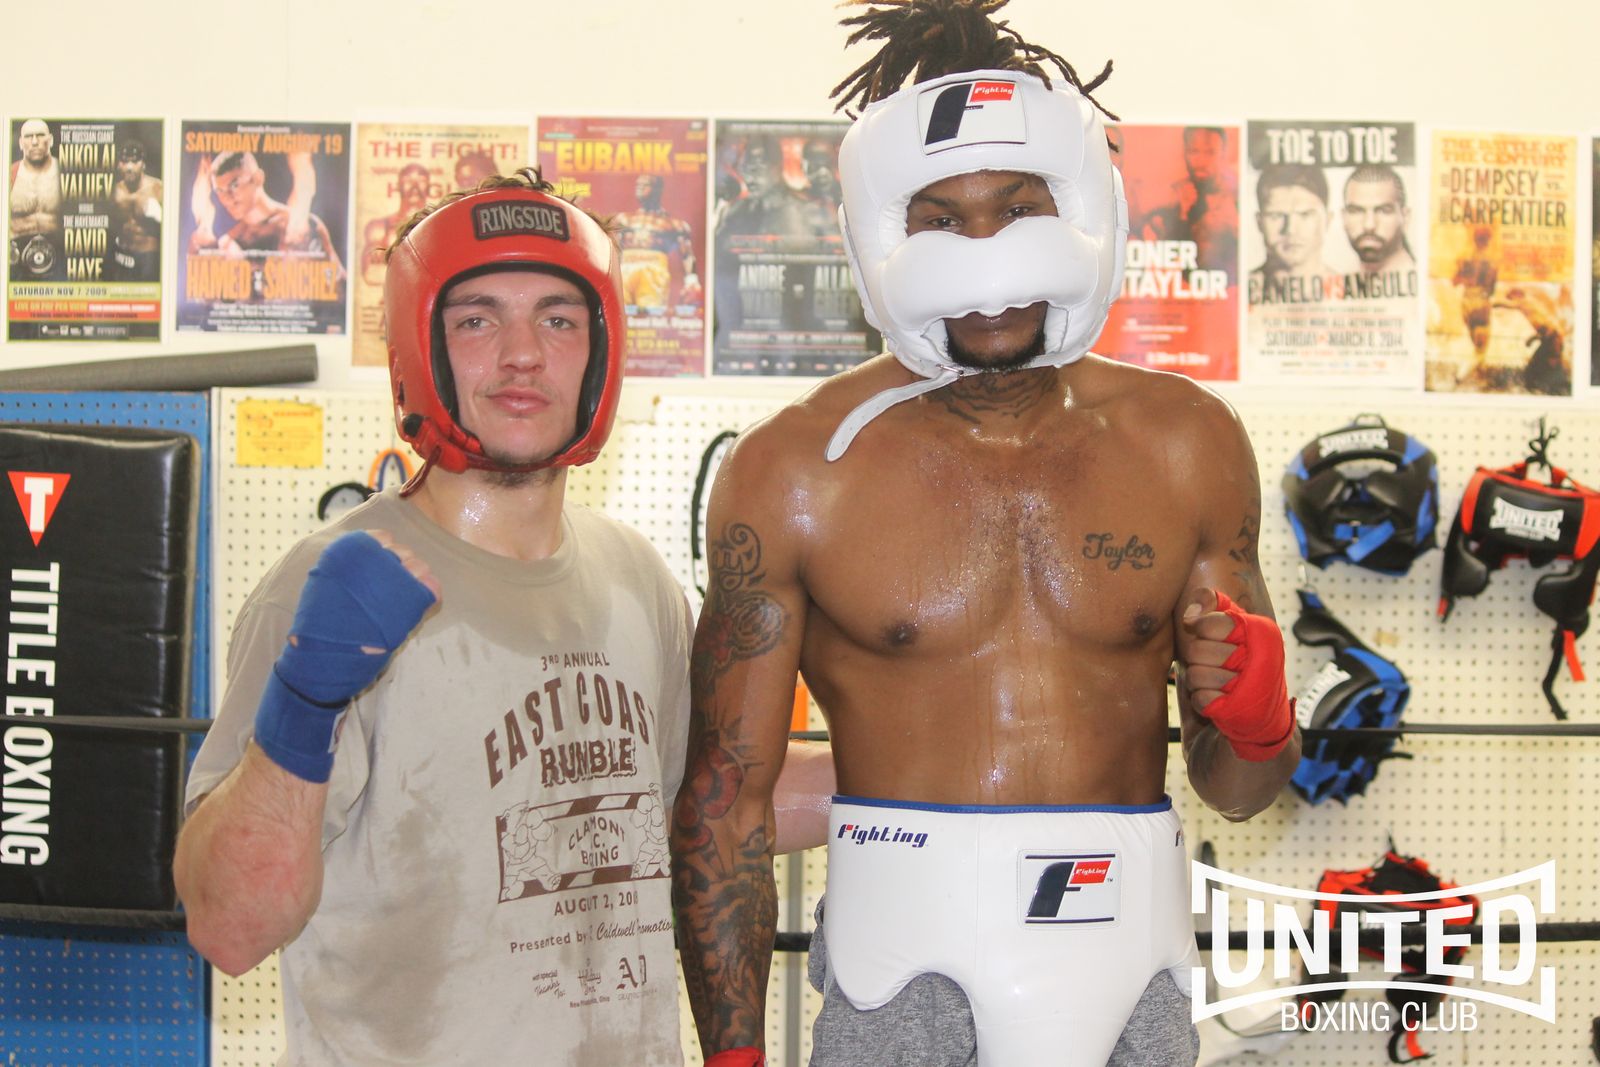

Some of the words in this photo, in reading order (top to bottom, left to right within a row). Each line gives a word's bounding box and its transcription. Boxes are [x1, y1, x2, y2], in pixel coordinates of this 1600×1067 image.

[185, 131, 261, 153] SATURDAY
[263, 132, 322, 154] AUGUST
[324, 134, 343, 155] 19
[368, 140, 421, 158] THE
[431, 141, 518, 160] FIGHT!
[556, 140, 674, 176] EUBANK
[1267, 128, 1316, 164] TOE
[1318, 130, 1350, 164] TO
[1349, 126, 1398, 164] TOE
[1450, 167, 1539, 197] DEMPSEY
[480, 205, 564, 235] RINGSIDE
[1450, 196, 1566, 227] CARPENTIER
[64, 228, 107, 255] DAVID
[1127, 240, 1198, 269] ONER
[13, 286, 55, 297] SATURDAY
[57, 286, 75, 297] NOV
[186, 256, 252, 300] HAMED
[263, 256, 338, 301] SANCHEZ
[738, 264, 787, 292] ANDRE
[1124, 269, 1228, 299] TAYLOR
[1248, 275, 1323, 305] CANELO
[1344, 270, 1418, 300] ANGULO
[1266, 332, 1317, 347] SATURDAY
[7, 562, 60, 687] TITLE
[541, 654, 560, 671] 3RD
[564, 652, 611, 668] ANNUAL
[484, 677, 564, 789] EAST
[576, 671, 655, 745] COAS
[0, 696, 54, 866] BOXING
[837, 823, 929, 848] Fighting
[510, 931, 571, 953] Presented
[596, 920, 636, 941] Caldwell
